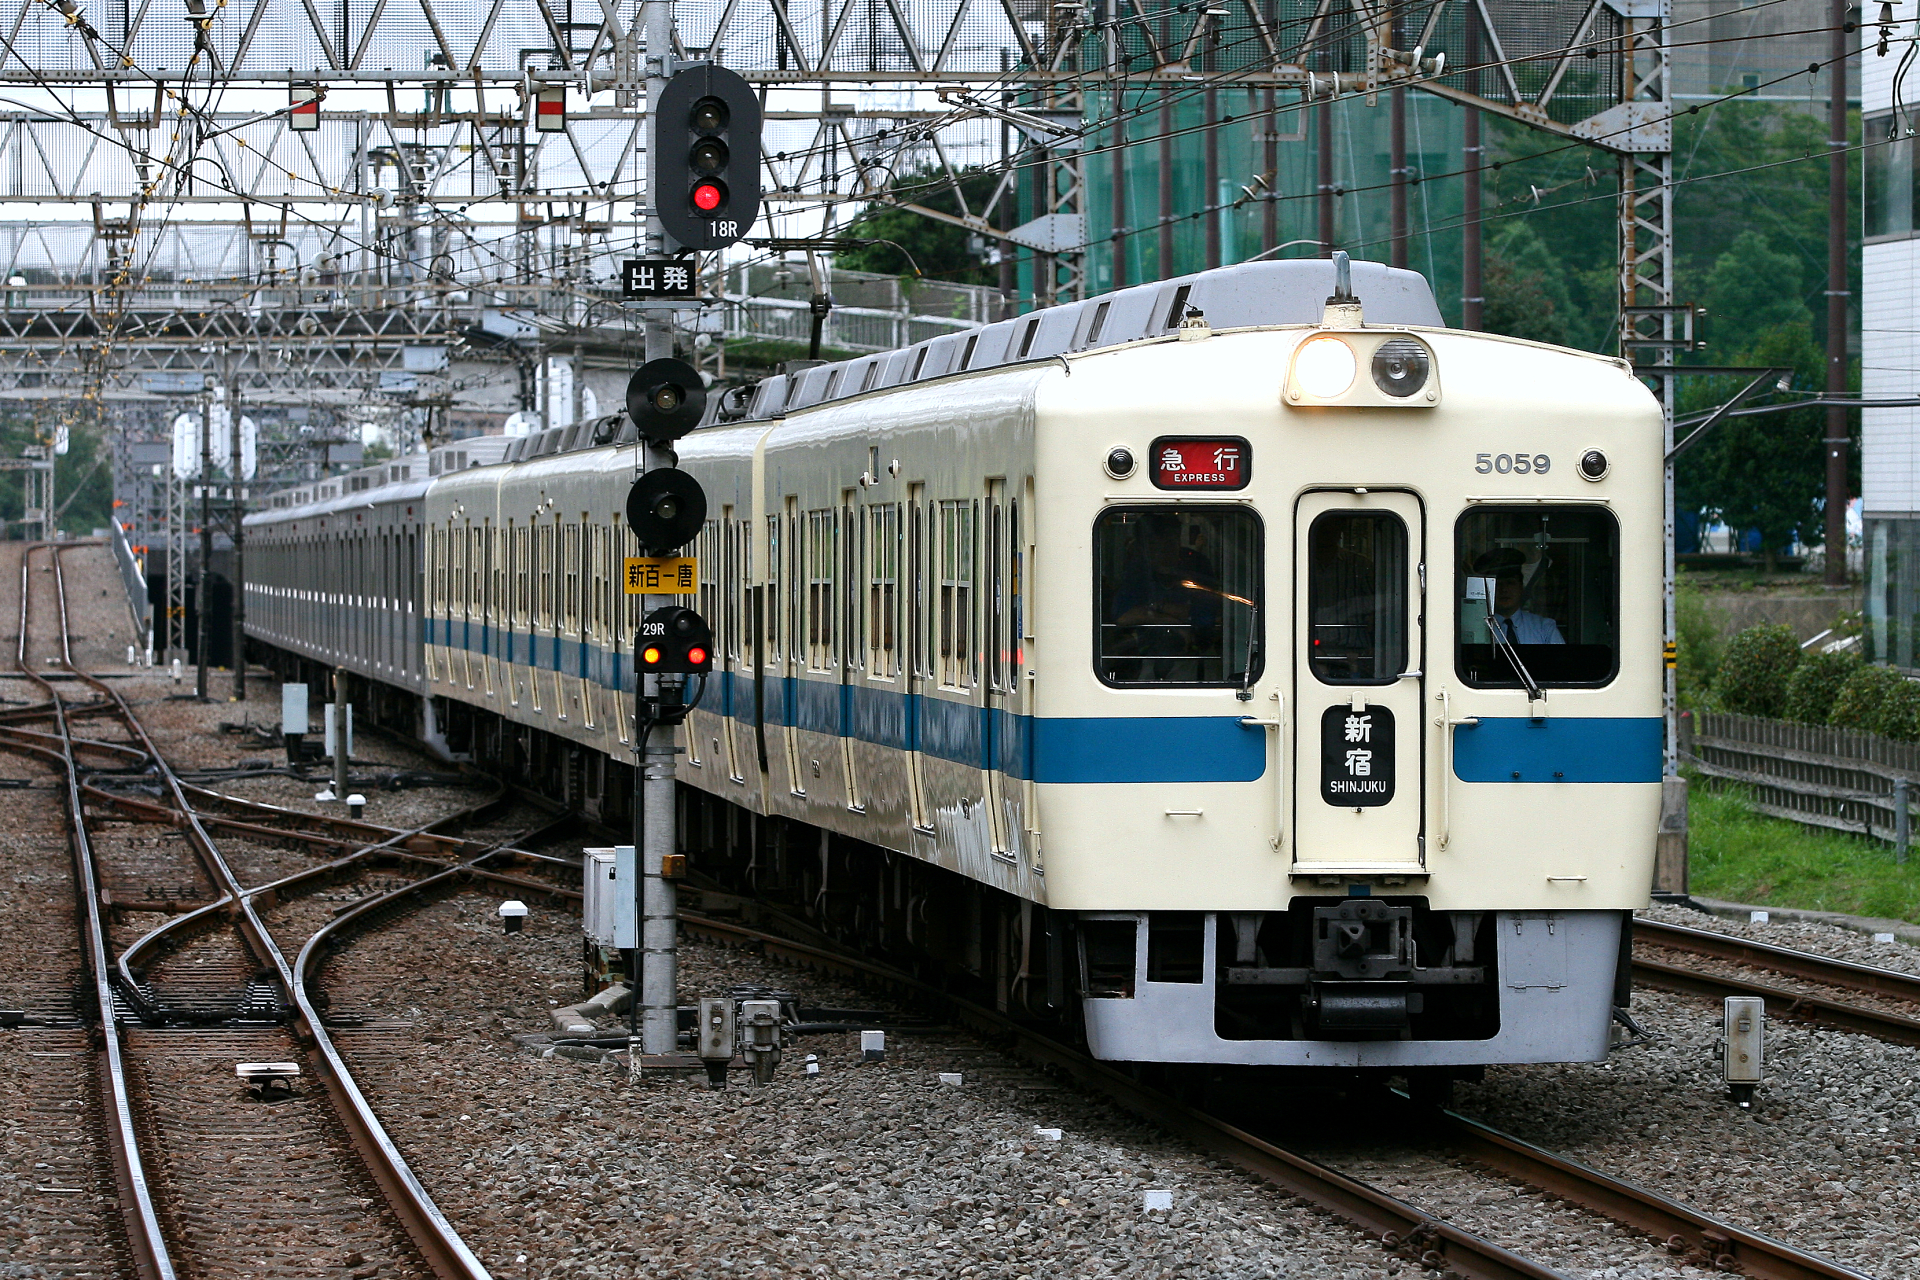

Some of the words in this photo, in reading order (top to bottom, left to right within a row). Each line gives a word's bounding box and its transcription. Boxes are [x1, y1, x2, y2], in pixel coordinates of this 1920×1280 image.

[710, 220, 738, 238] 18R
[631, 266, 689, 291] 出発
[1474, 453, 1551, 475] 5059
[1173, 473, 1226, 482] EXPRESS
[642, 622, 665, 636] 29R
[1344, 714, 1373, 776] 新宿
[1330, 780, 1387, 793] SHINJUKU
